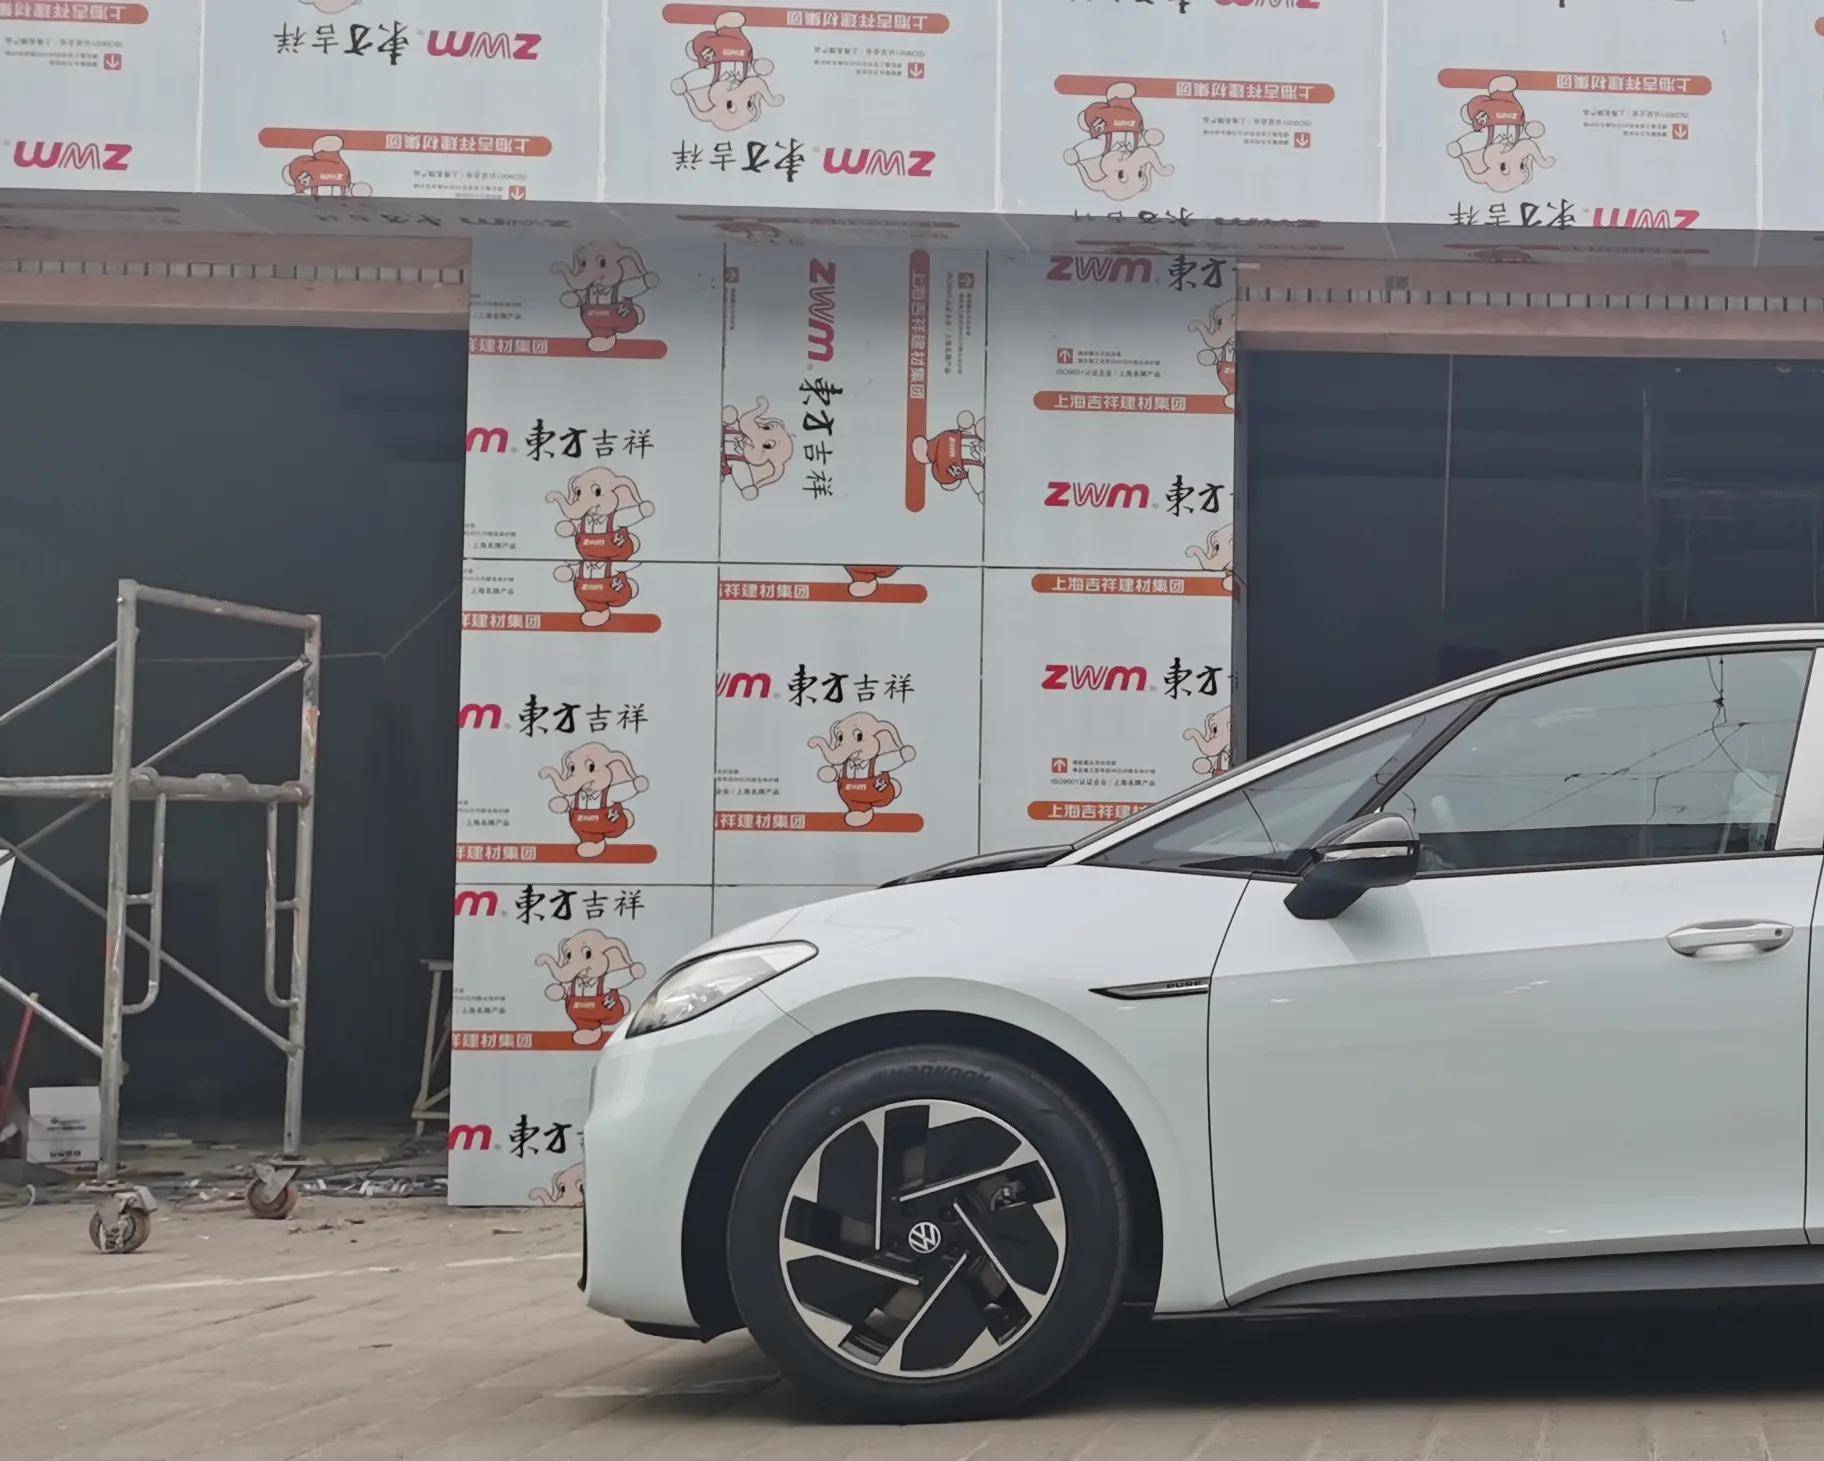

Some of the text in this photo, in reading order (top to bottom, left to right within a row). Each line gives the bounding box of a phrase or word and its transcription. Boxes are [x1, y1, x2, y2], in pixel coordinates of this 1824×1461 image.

[427, 31, 541, 61] zwm
[14, 141, 132, 171] zwm
[823, 148, 935, 177] zwm
[1046, 255, 1153, 283] zwm
[808, 258, 835, 363] zwm
[1053, 394, 1186, 411] 上海吉祥建材集团
[1044, 481, 1150, 509] zwm
[1051, 576, 1185, 593] 上海吉祥建材集团
[1041, 664, 1149, 692] zwm
[509, 1114, 585, 1158] 東方
